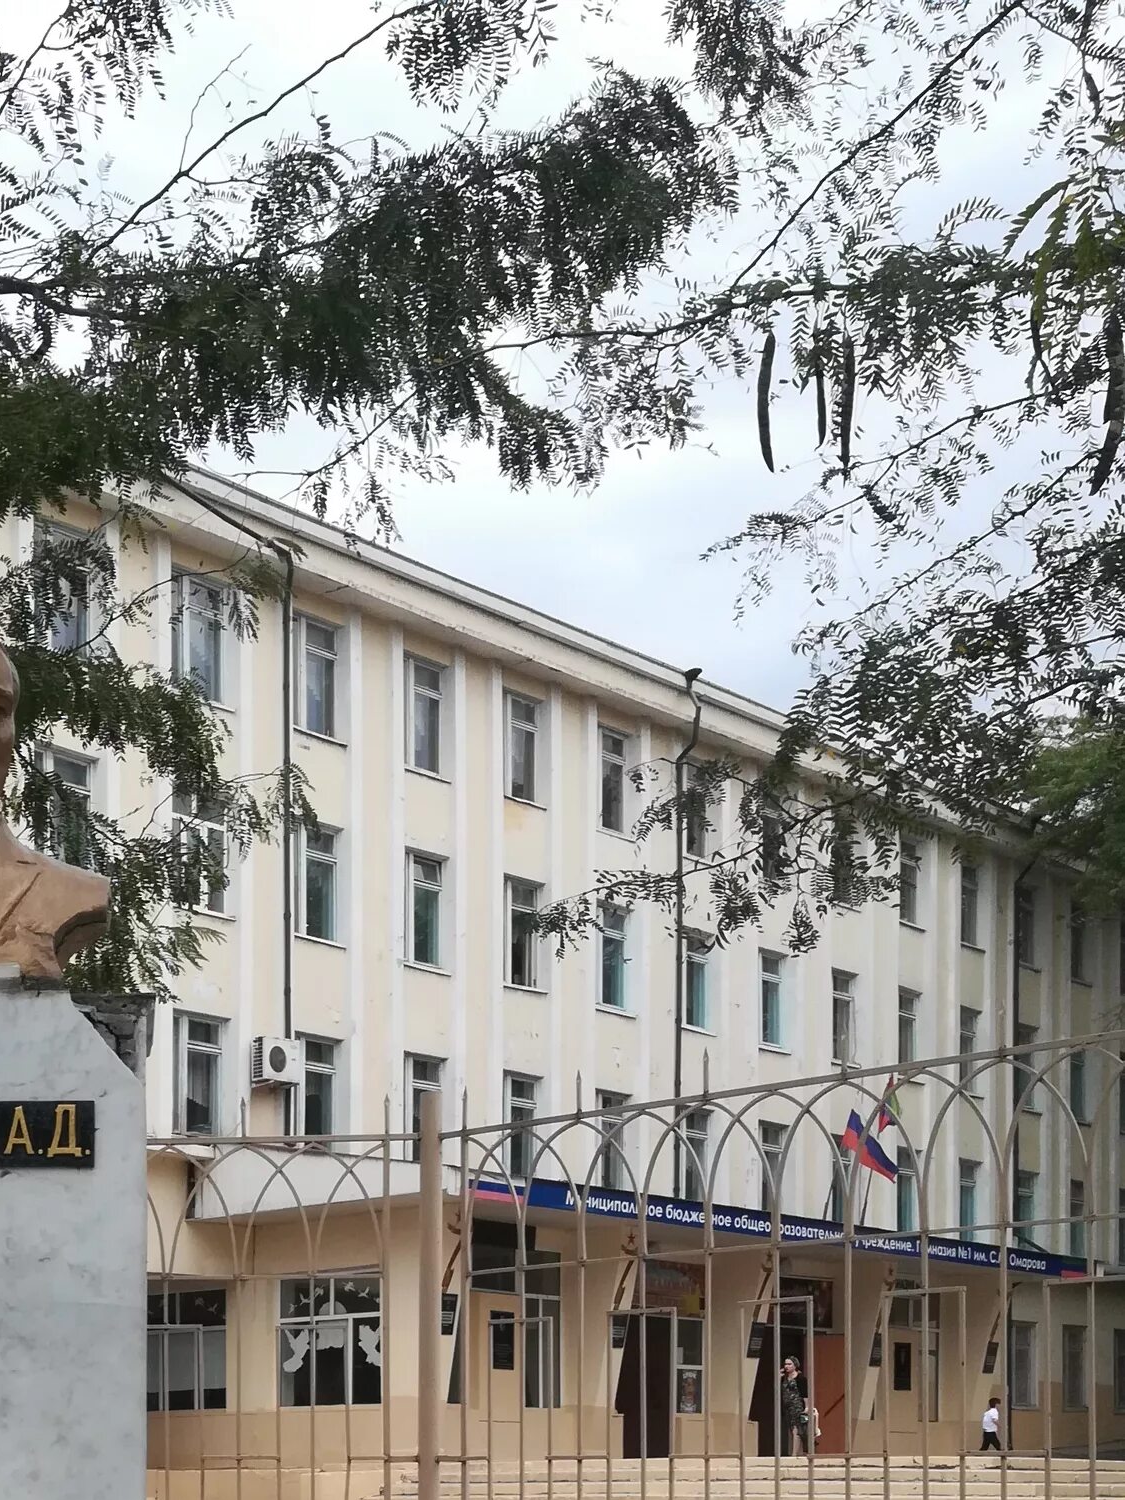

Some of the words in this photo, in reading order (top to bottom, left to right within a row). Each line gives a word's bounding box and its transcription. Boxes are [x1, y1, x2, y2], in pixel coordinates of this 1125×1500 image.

[3, 1103, 91, 1159] А.Д.
[565, 1190, 663, 1218] Мниципалое
[665, 1204, 732, 1228] бюдженое
[916, 1240, 956, 1258] Гмназия
[958, 1248, 971, 1260] №1
[973, 1252, 987, 1262] им.
[1009, 1253, 1047, 1270] Омарова
